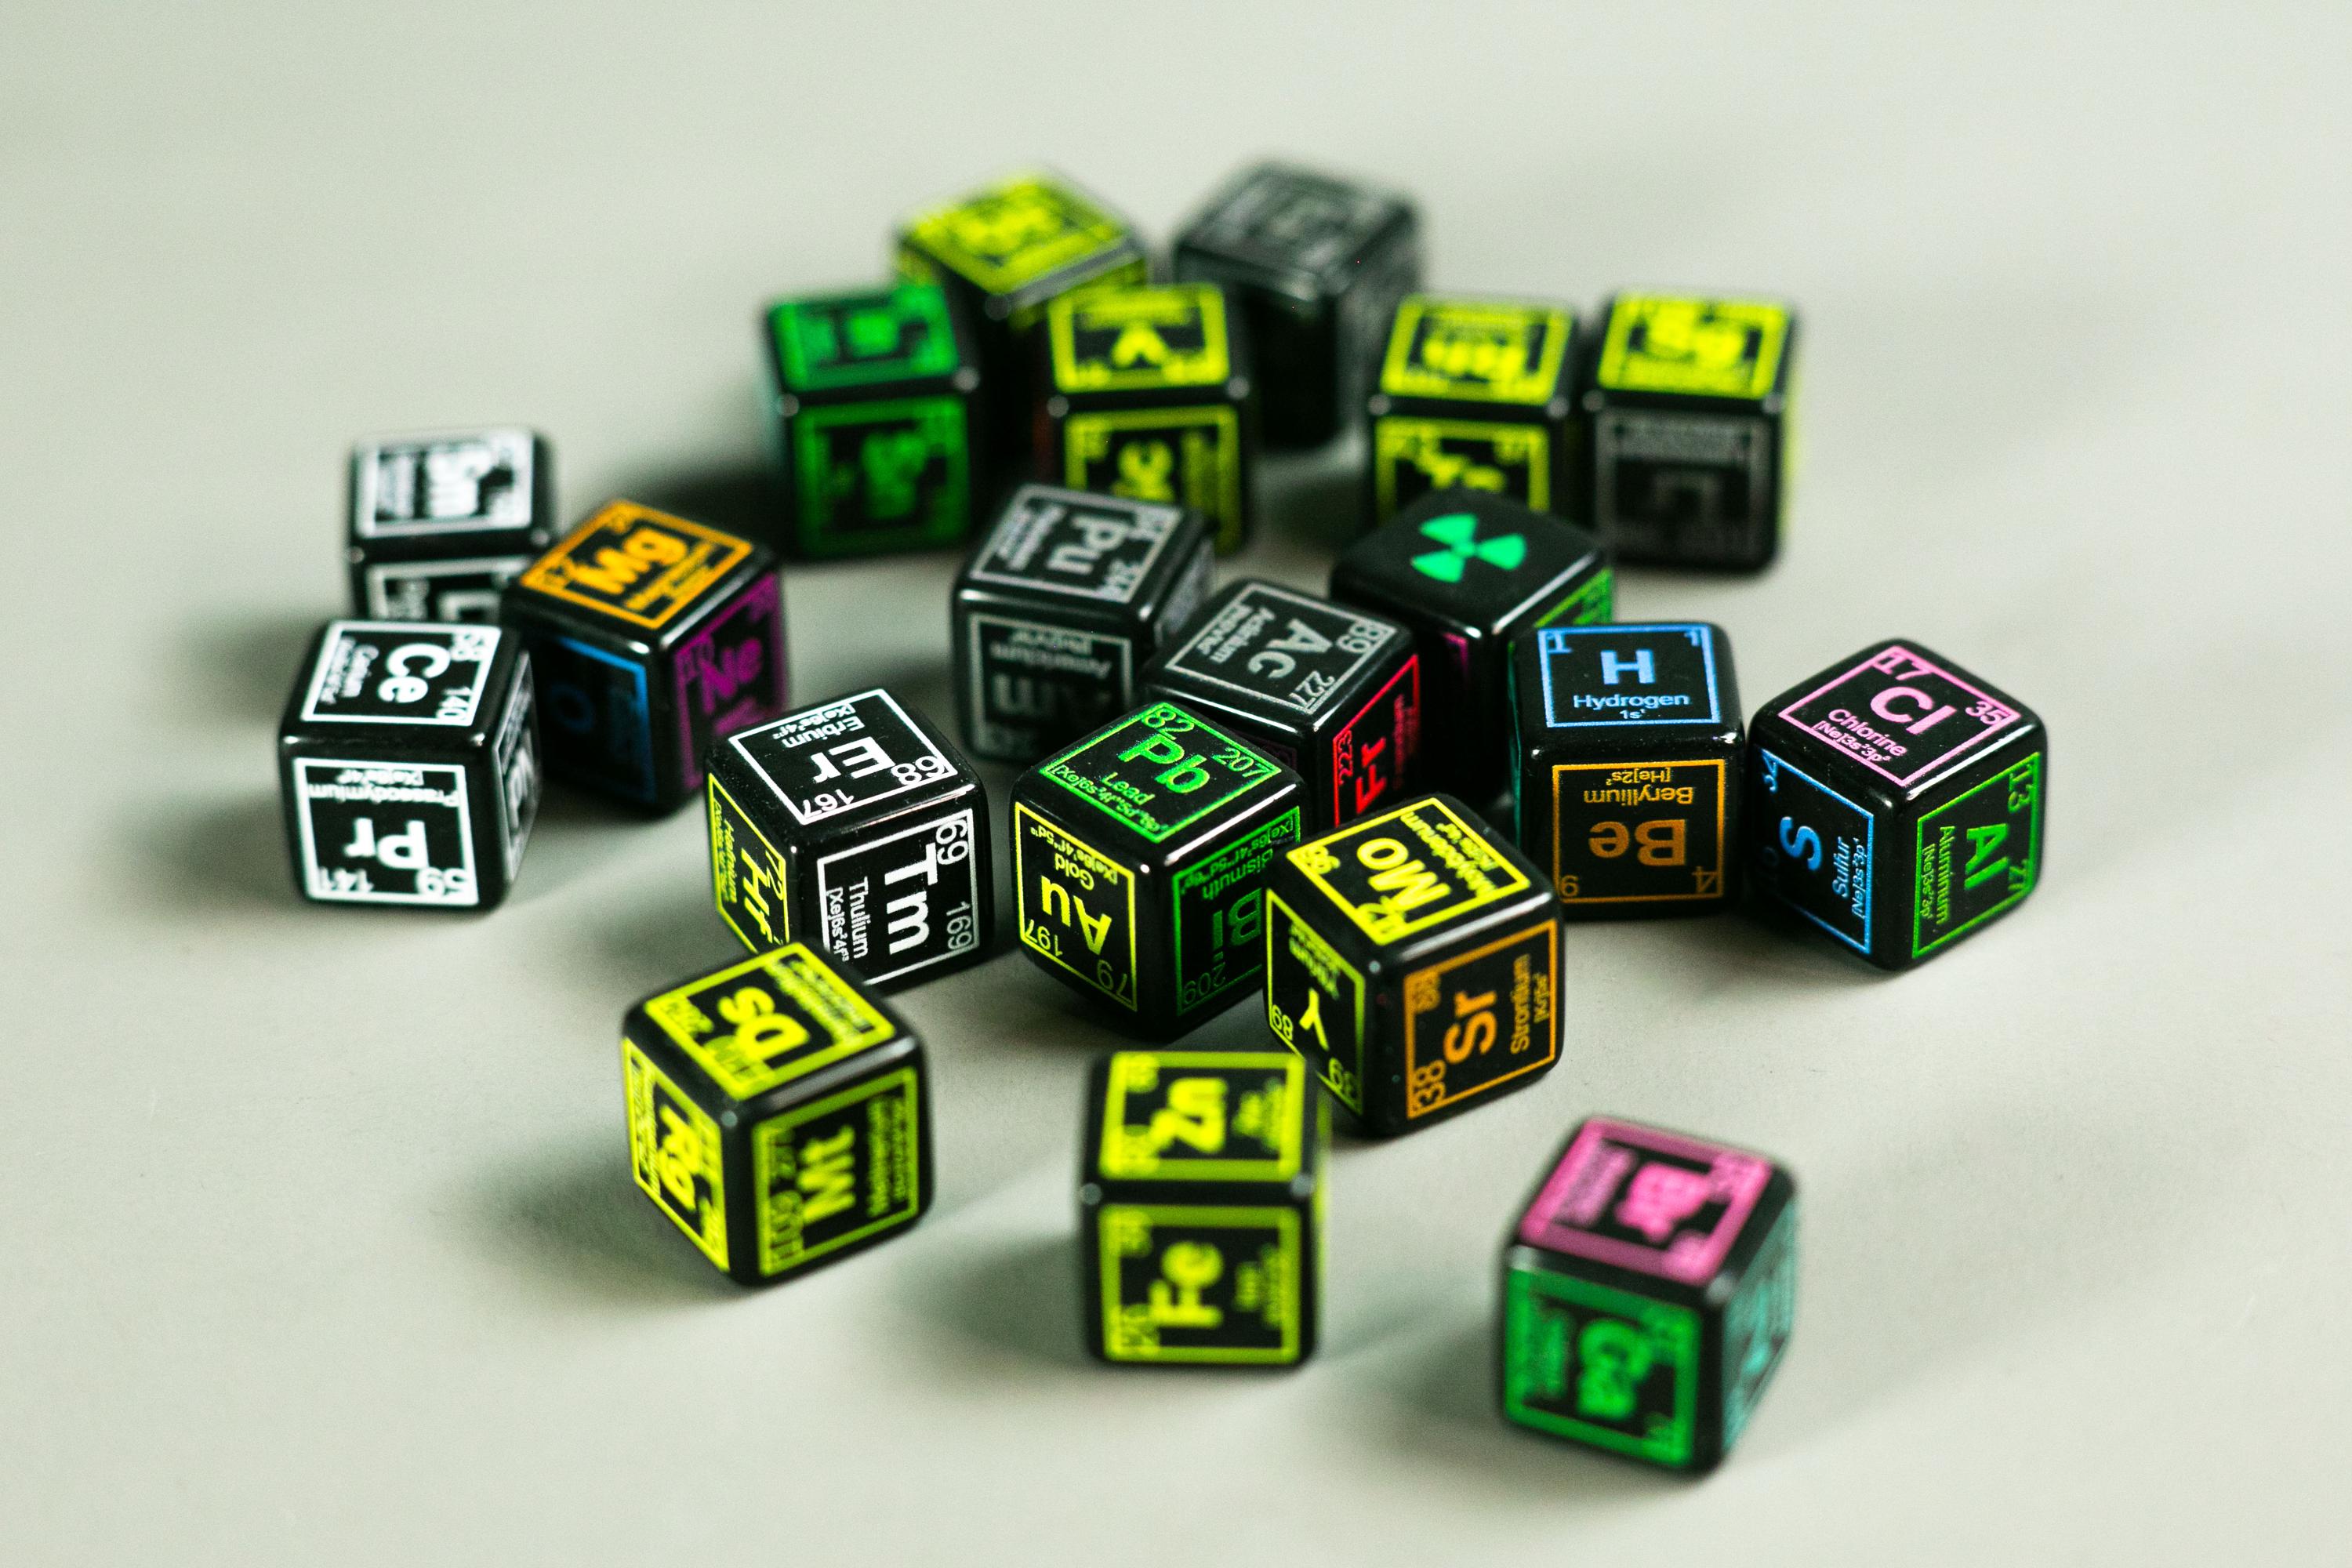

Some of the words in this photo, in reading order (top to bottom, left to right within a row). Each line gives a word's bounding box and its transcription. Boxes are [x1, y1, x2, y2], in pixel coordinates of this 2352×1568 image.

[566, 526, 687, 595] Mg
[1047, 514, 1131, 574] Pu
[1247, 618, 1333, 678] Ac
[1337, 622, 1380, 654] 89
[378, 643, 450, 703] Ce
[701, 638, 762, 713] Ne
[1290, 671, 1334, 705] 227
[1601, 649, 1655, 684] H
[1872, 655, 1932, 681] 17
[1142, 710, 1195, 740] 82
[1573, 694, 1690, 710] Hydrogen
[1871, 687, 1957, 735] Cl
[1965, 701, 2009, 726] 35
[782, 716, 865, 747] Erbium
[1829, 710, 1907, 756] Chlorine
[809, 736, 895, 782] Er
[891, 755, 946, 786] 68
[1118, 733, 1210, 793] Pb
[1212, 748, 1267, 778] 207
[1356, 737, 1386, 814] Fr
[803, 789, 855, 817] 167
[1102, 772, 1156, 805] Lead
[1584, 784, 1693, 805] Beryllium
[2008, 762, 2035, 812] 13
[343, 818, 429, 869] Pr
[936, 817, 969, 865] 69
[1589, 819, 1686, 866] Be
[1780, 816, 1822, 870] S
[1965, 822, 2009, 890] Al
[416, 867, 468, 897] 59
[765, 851, 783, 900] 72
[1054, 853, 1094, 890] Gold
[1357, 838, 1450, 911] Mo
[1561, 876, 1579, 897] 9
[1692, 866, 1717, 894] 4
[1832, 837, 1849, 897] Sulfur
[1936, 826, 1955, 924] Aluminum
[741, 848, 772, 941] Hf
[849, 877, 871, 958] Thulium
[884, 843, 938, 954] Tm
[1041, 875, 1112, 955] Au
[946, 902, 972, 950] 169
[1025, 919, 1063, 956] 197
[1213, 887, 1261, 960] Bi
[1098, 959, 1131, 1000] 79
[1184, 960, 1227, 1004] 209
[718, 986, 811, 1062] Ds
[1272, 1004, 1294, 1041] 89
[1299, 989, 1328, 1049] Y
[1443, 991, 1497, 1065] Sr
[1511, 955, 1530, 1054] Strontium
[1414, 1059, 1446, 1108] 38
[1149, 1077, 1228, 1154] Zn
[797, 1124, 855, 1225] Mt
[1148, 1242, 1224, 1329] Fe
